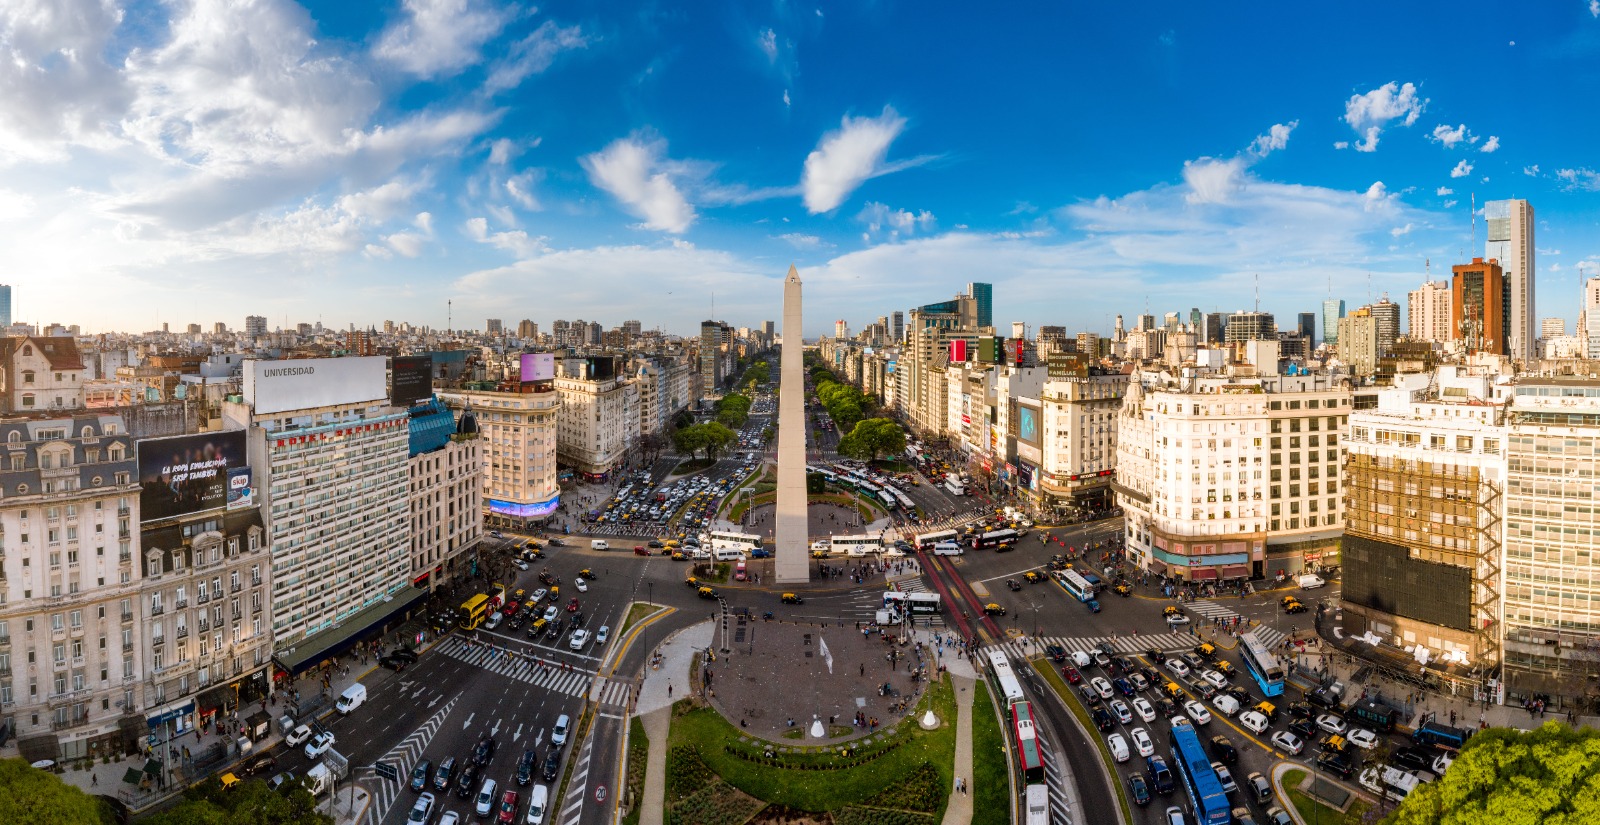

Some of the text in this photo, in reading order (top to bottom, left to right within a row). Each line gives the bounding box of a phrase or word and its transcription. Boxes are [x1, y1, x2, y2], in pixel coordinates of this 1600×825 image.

[264, 366, 314, 378] UNIVERSIDAD
[277, 433, 327, 447] HOTEL
[162, 466, 170, 474] LA
[172, 464, 188, 472] ROPA
[232, 477, 246, 486] skip
[597, 788, 606, 798] 20
